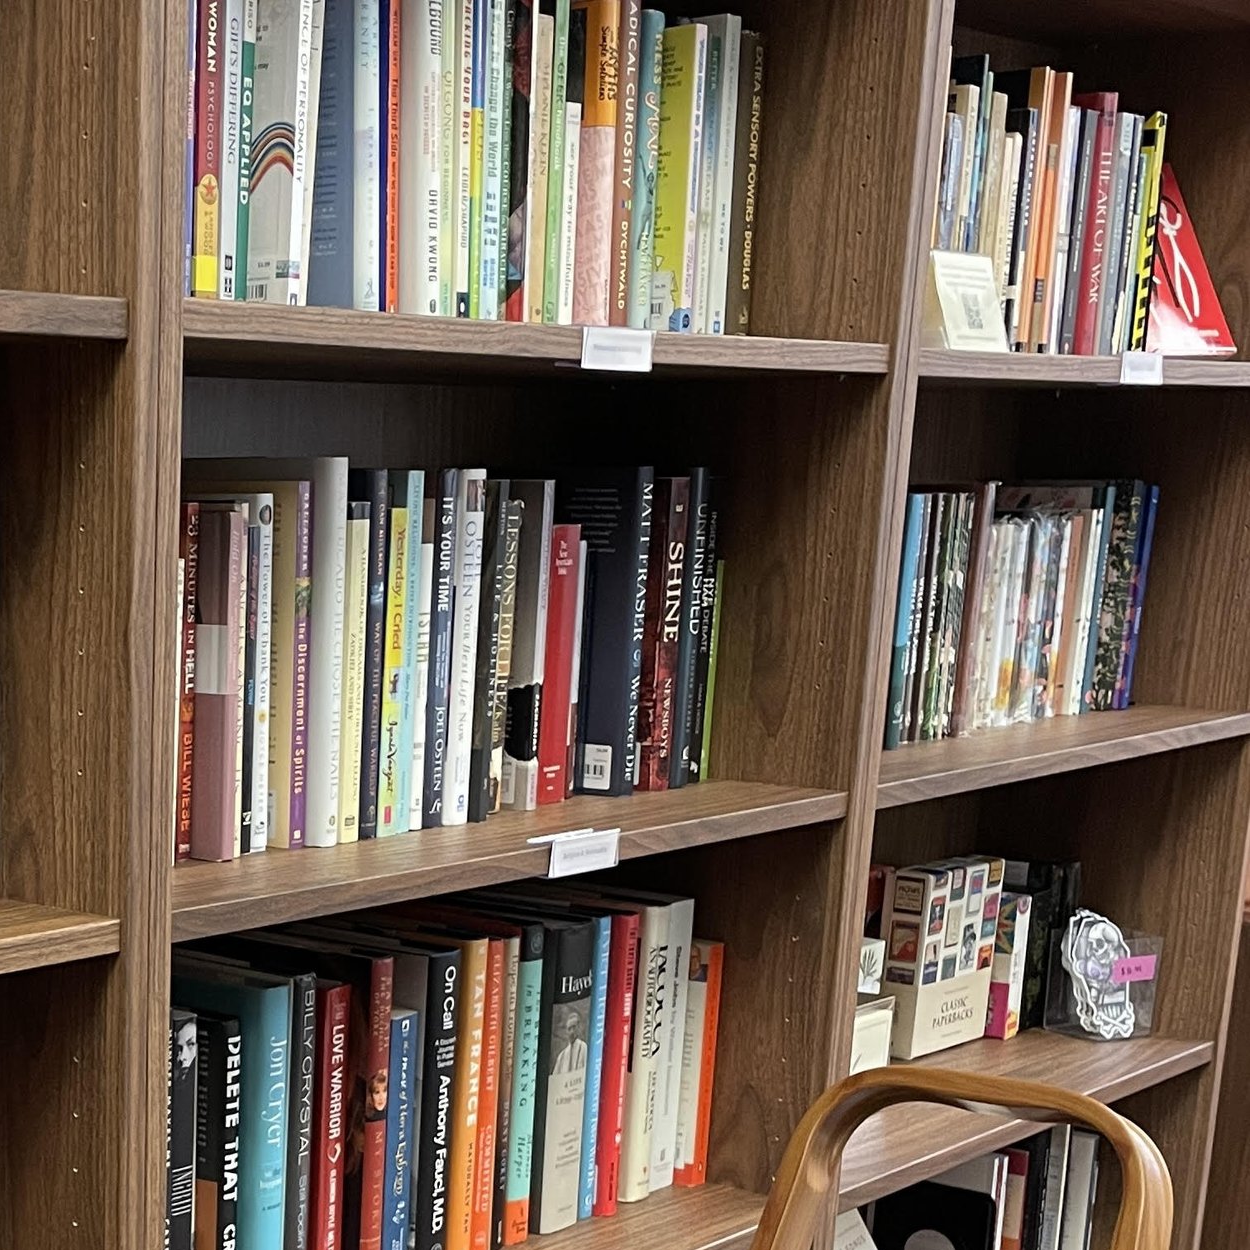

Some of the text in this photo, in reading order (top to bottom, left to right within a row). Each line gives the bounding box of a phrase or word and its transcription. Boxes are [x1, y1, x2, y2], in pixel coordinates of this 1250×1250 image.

[240, 77, 253, 205] EQ APPLIED
[623, 82, 636, 189] CURIOSITY
[617, 220, 628, 308] DYCHTWALD
[438, 497, 452, 612] IT'S YOUR TIME
[663, 542, 684, 643] SHINE
[442, 965, 456, 1030] On Call
[466, 968, 488, 1127] TAN FRANCE
[932, 1007, 973, 1029] PAPERBACKS
[224, 1036, 242, 1127] DELETE
[297, 989, 315, 1166] BILLY CRYSTAL
[328, 1024, 344, 1141] LOVE WARRIOR
[223, 1136, 239, 1201] THAT
